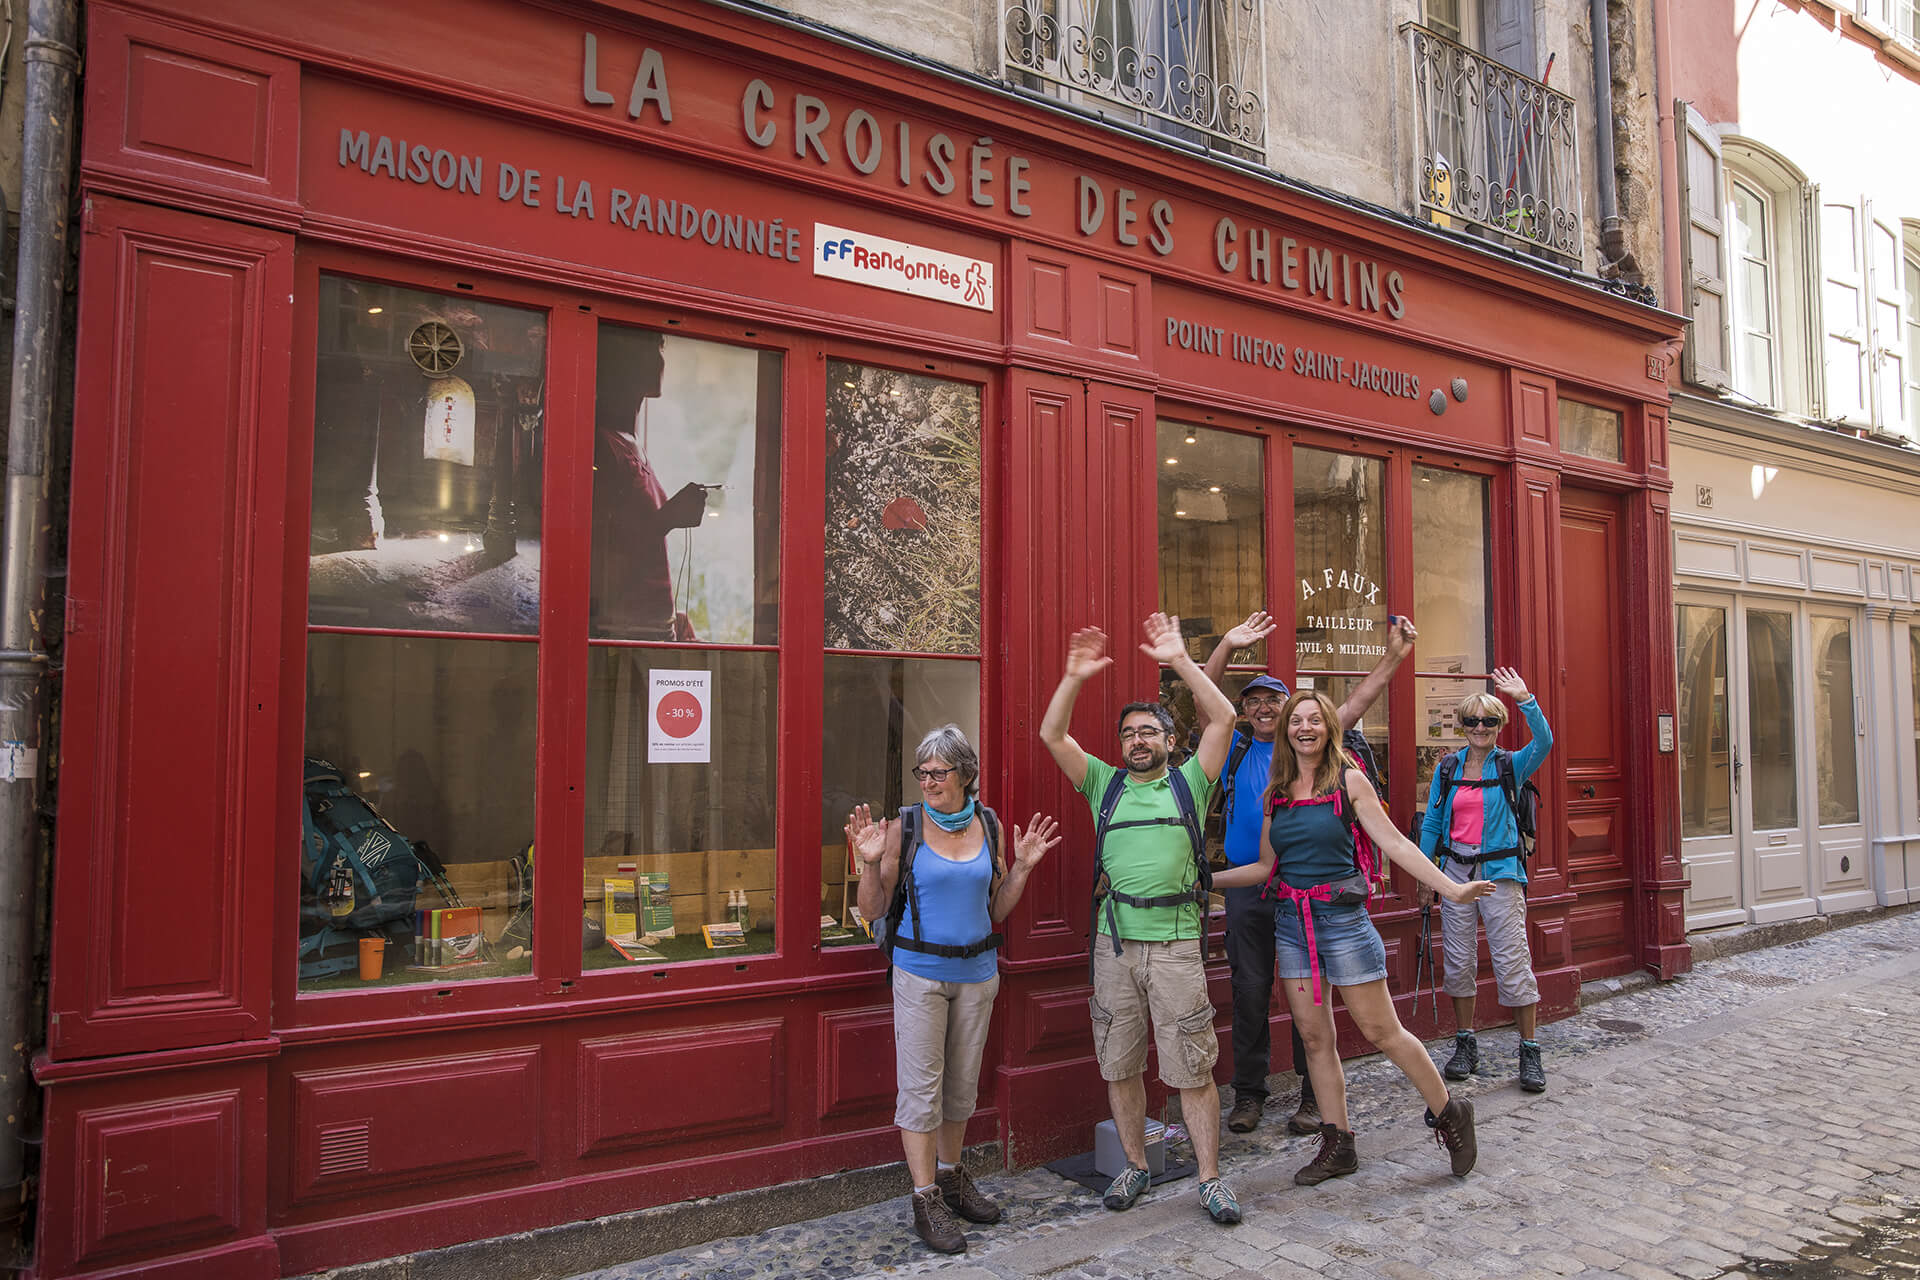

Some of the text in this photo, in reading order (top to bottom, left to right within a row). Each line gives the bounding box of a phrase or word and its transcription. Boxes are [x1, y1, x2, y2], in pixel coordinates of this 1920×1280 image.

[338, 128, 801, 262] MAISON DE LA RANDONNÉE
[583, 32, 1405, 320] LA CROISÉE DES CHEMINS
[1166, 317, 1421, 400] POINT INFOS SAINT-JACQUES
[1306, 615, 1374, 632] TAILLEUR
[1326, 643, 1334, 654] &
[656, 679, 685, 687] PROMOS
